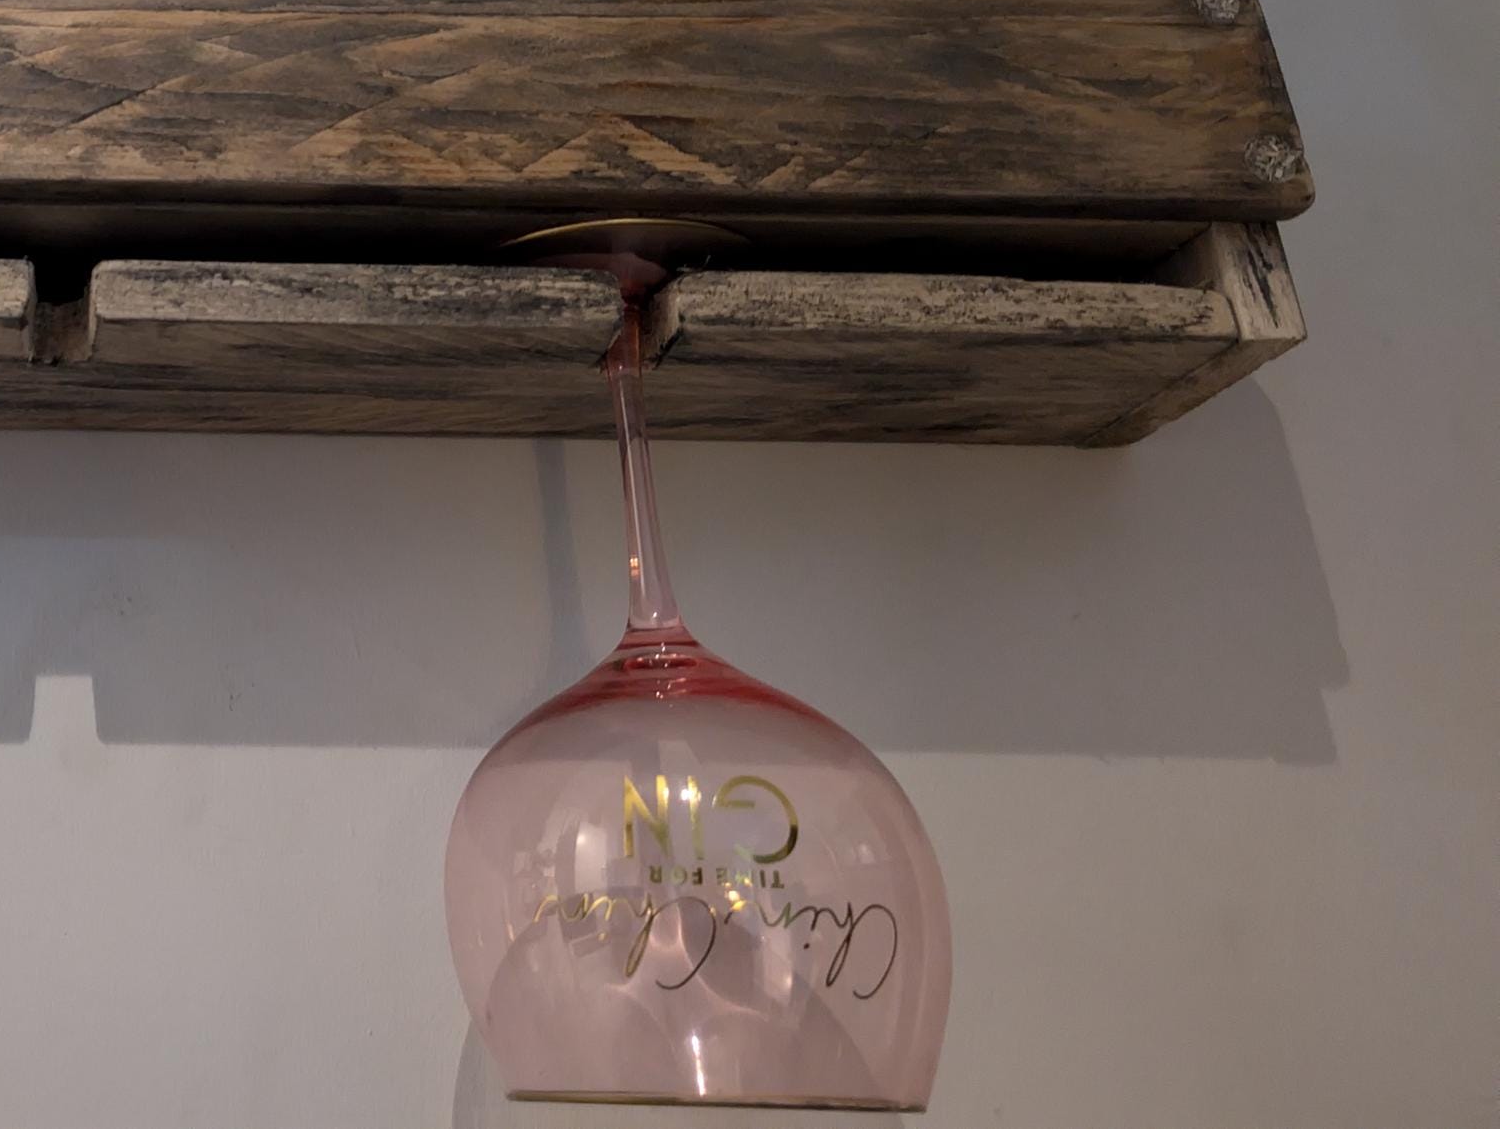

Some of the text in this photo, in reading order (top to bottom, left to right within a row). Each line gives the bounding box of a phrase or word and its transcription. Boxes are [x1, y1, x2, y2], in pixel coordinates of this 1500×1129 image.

[623, 774, 798, 864] GIN
[649, 865, 785, 889] TIME FOR
[534, 893, 897, 999] Chin Chin
